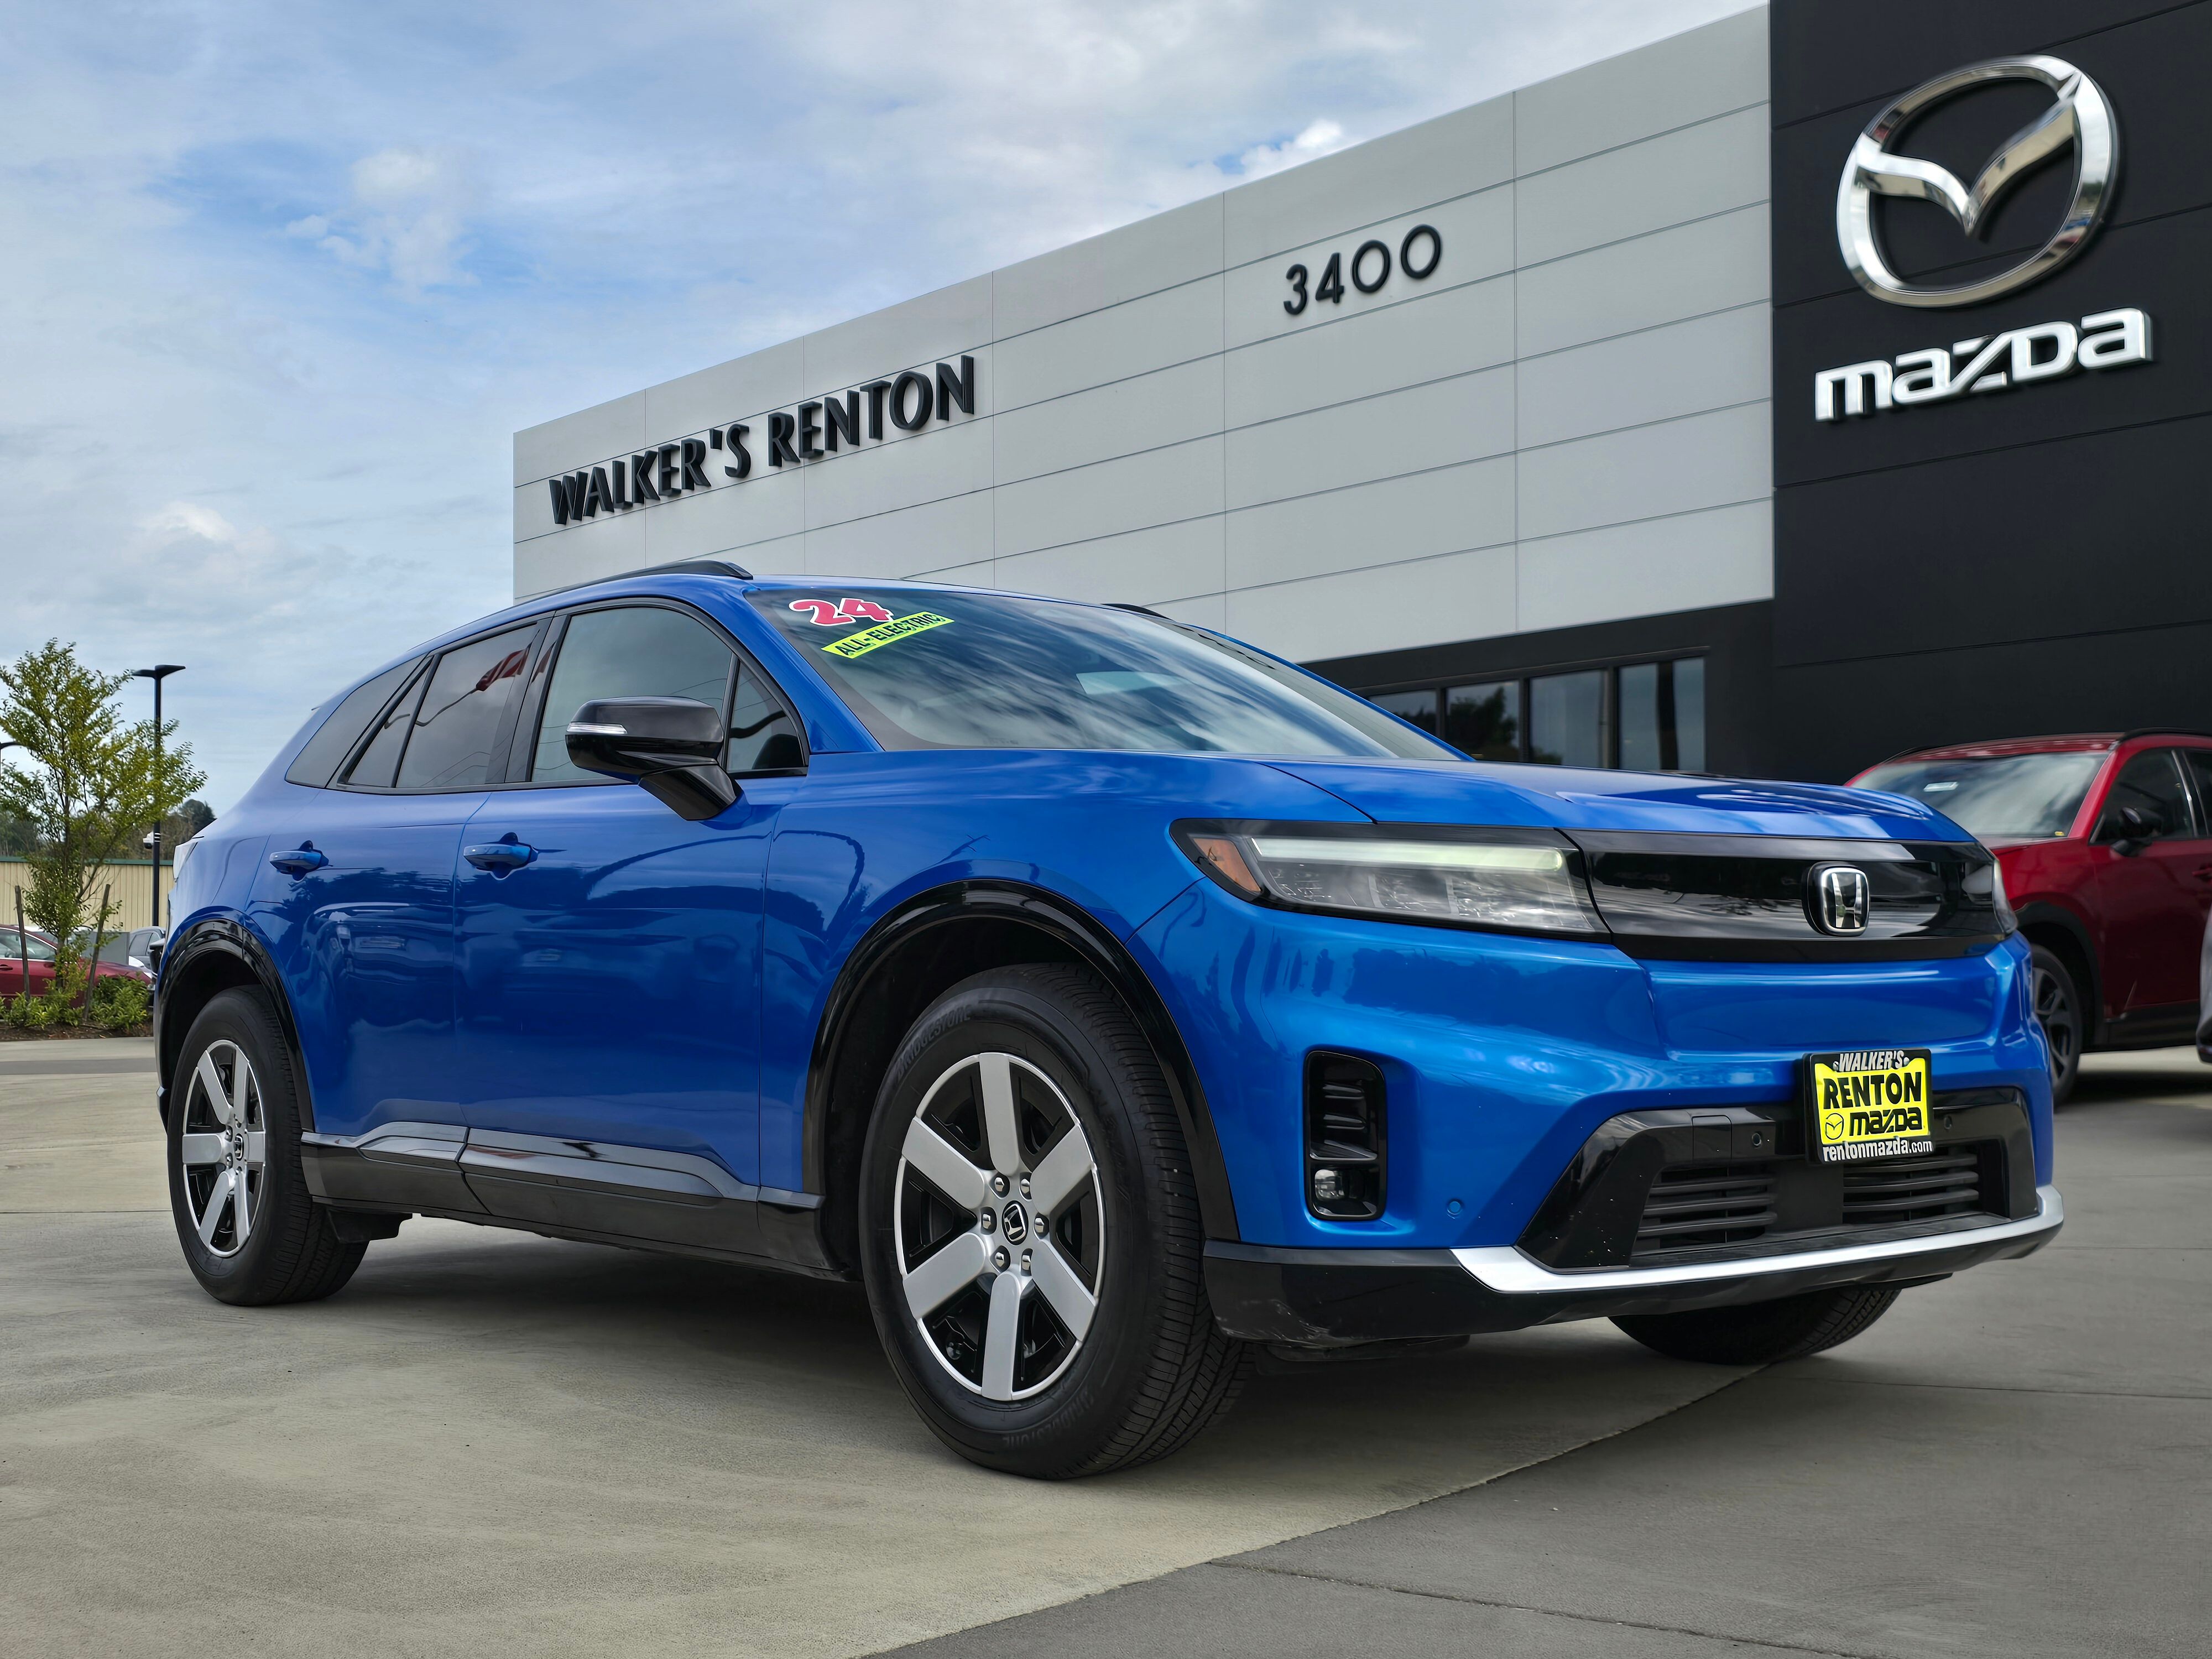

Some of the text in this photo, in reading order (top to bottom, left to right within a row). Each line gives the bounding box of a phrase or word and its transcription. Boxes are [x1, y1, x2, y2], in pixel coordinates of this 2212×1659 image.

[1283, 223, 1443, 315] 3400
[549, 354, 975, 525] WALKER'S RENTON
[789, 598, 894, 627] 24
[834, 613, 945, 656] ALL-ELECTRIC
[1839, 1050, 1905, 1072] WALKER'S
[1823, 1072, 1922, 1109] RENTON
[1823, 1136, 1933, 1161] rentonmazda.com
